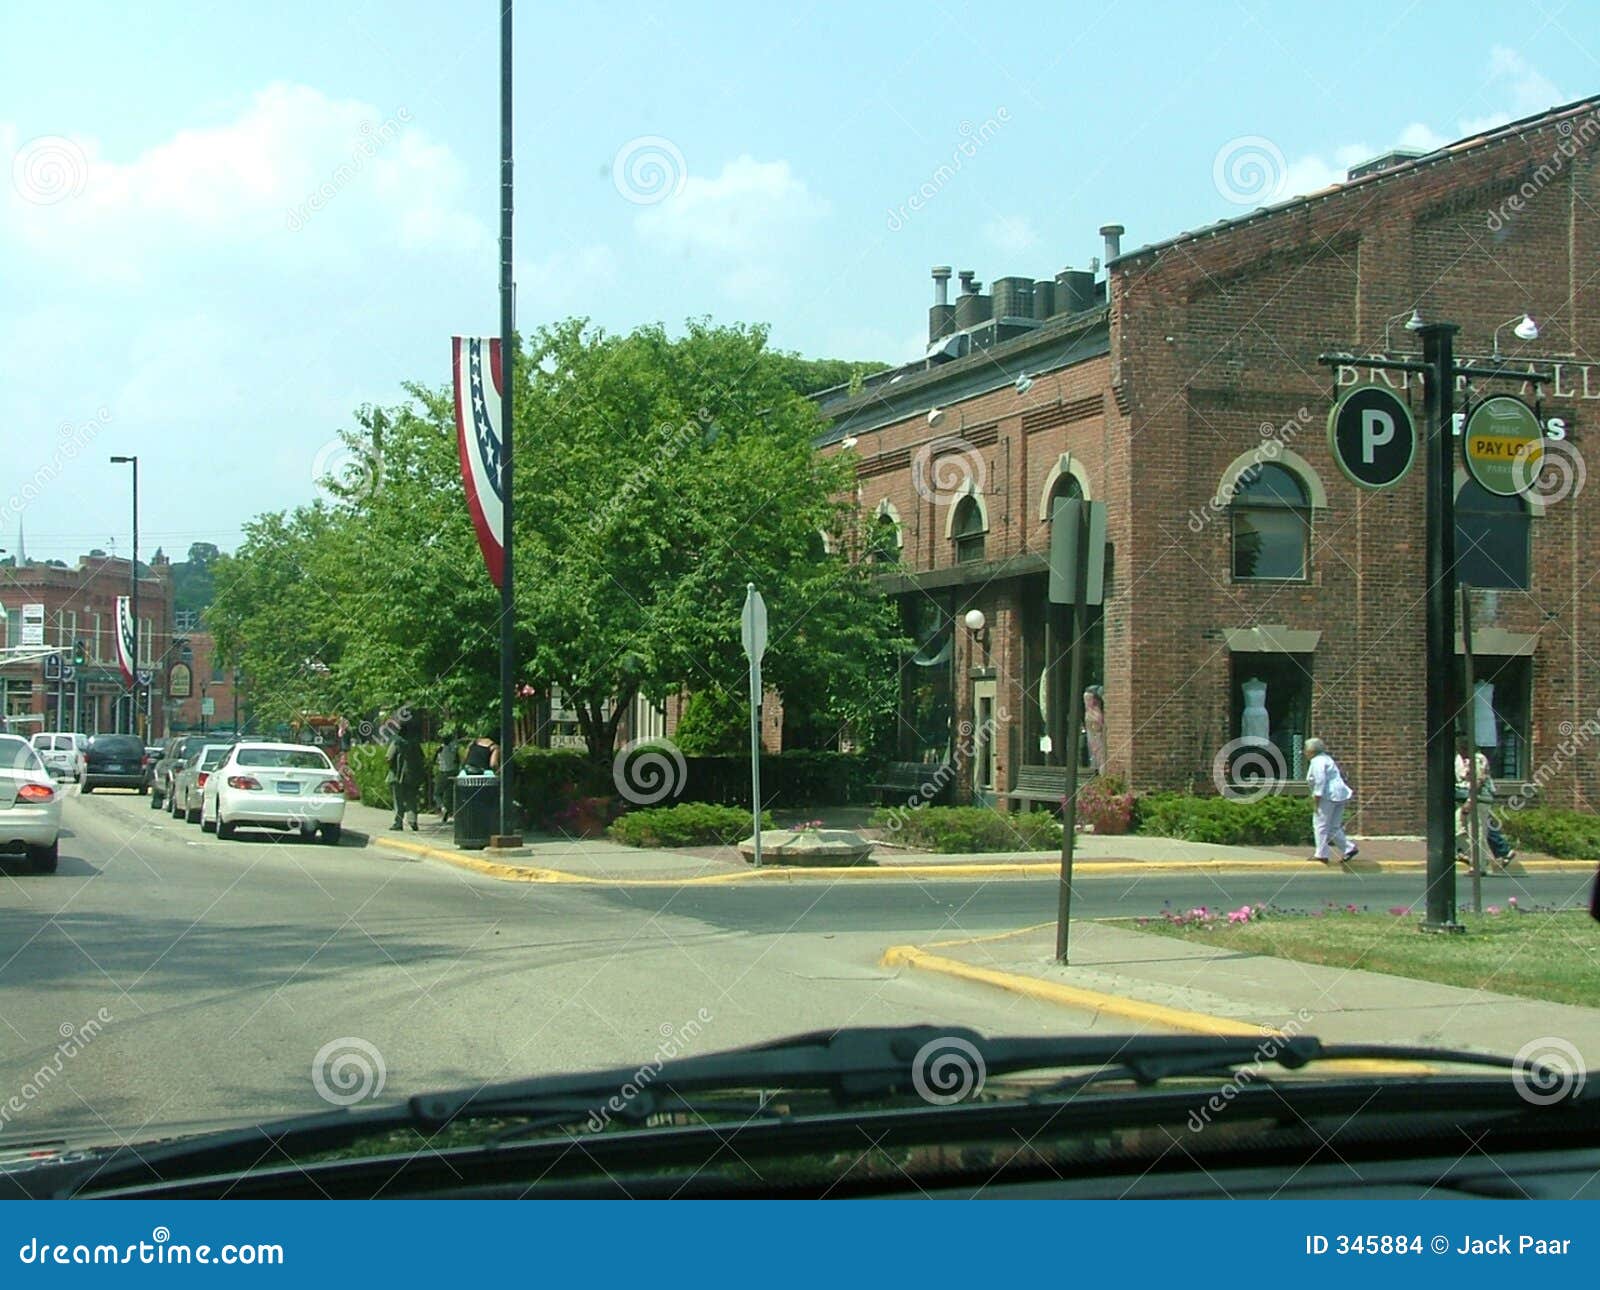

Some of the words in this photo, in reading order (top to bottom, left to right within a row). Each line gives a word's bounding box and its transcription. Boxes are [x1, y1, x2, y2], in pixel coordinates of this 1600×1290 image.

[1338, 353, 1481, 392] BRIK
[1362, 409, 1395, 463] P
[1476, 441, 1502, 455] PAY
[1507, 443, 1534, 458] LOT
